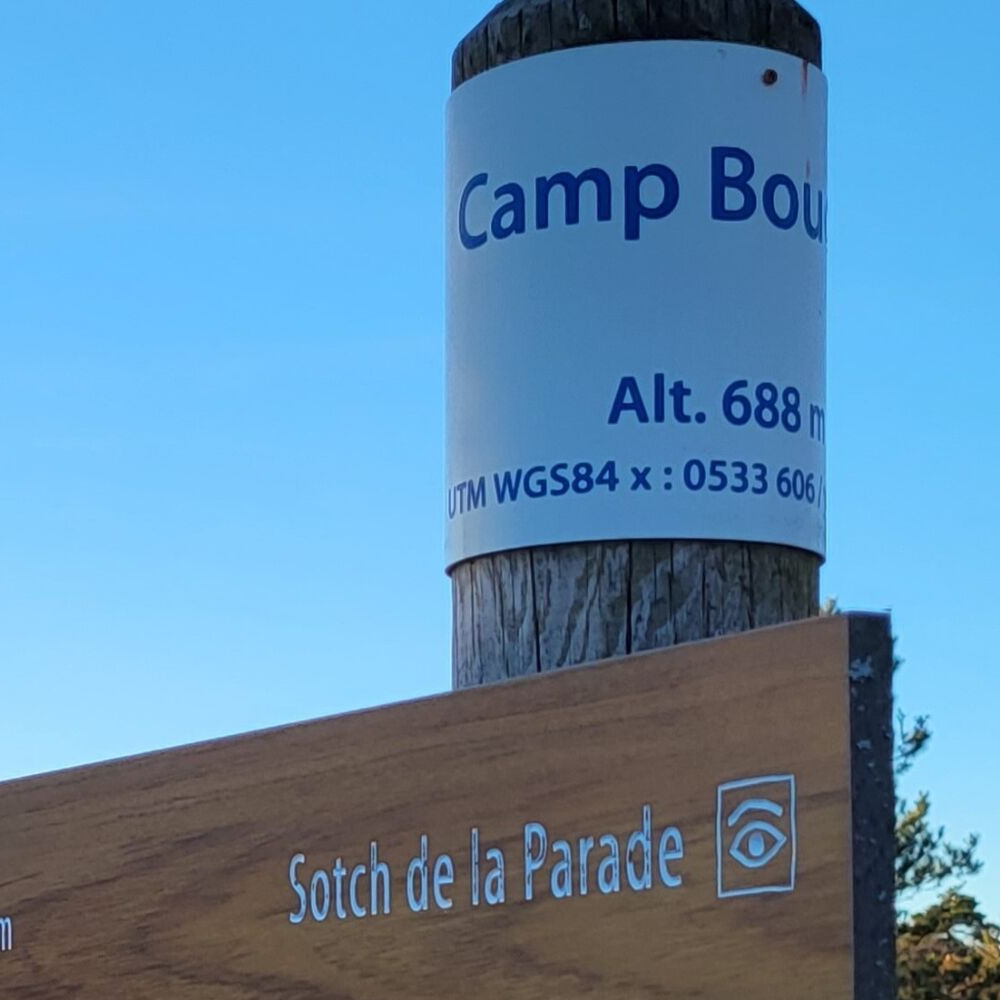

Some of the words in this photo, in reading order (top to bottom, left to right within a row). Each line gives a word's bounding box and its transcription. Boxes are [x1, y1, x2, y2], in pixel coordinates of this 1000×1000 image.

[458, 163, 680, 250] Camp
[711, 146, 828, 244] Bou
[607, 373, 707, 425] Alt.
[722, 379, 801, 433] 688
[448, 476, 486, 520] UTM
[493, 460, 619, 504] WGS84
[683, 459, 768, 495] 0533
[288, 841, 390, 923] Sotch
[406, 834, 454, 912] de
[472, 827, 505, 906] la
[523, 804, 684, 900] Parade
